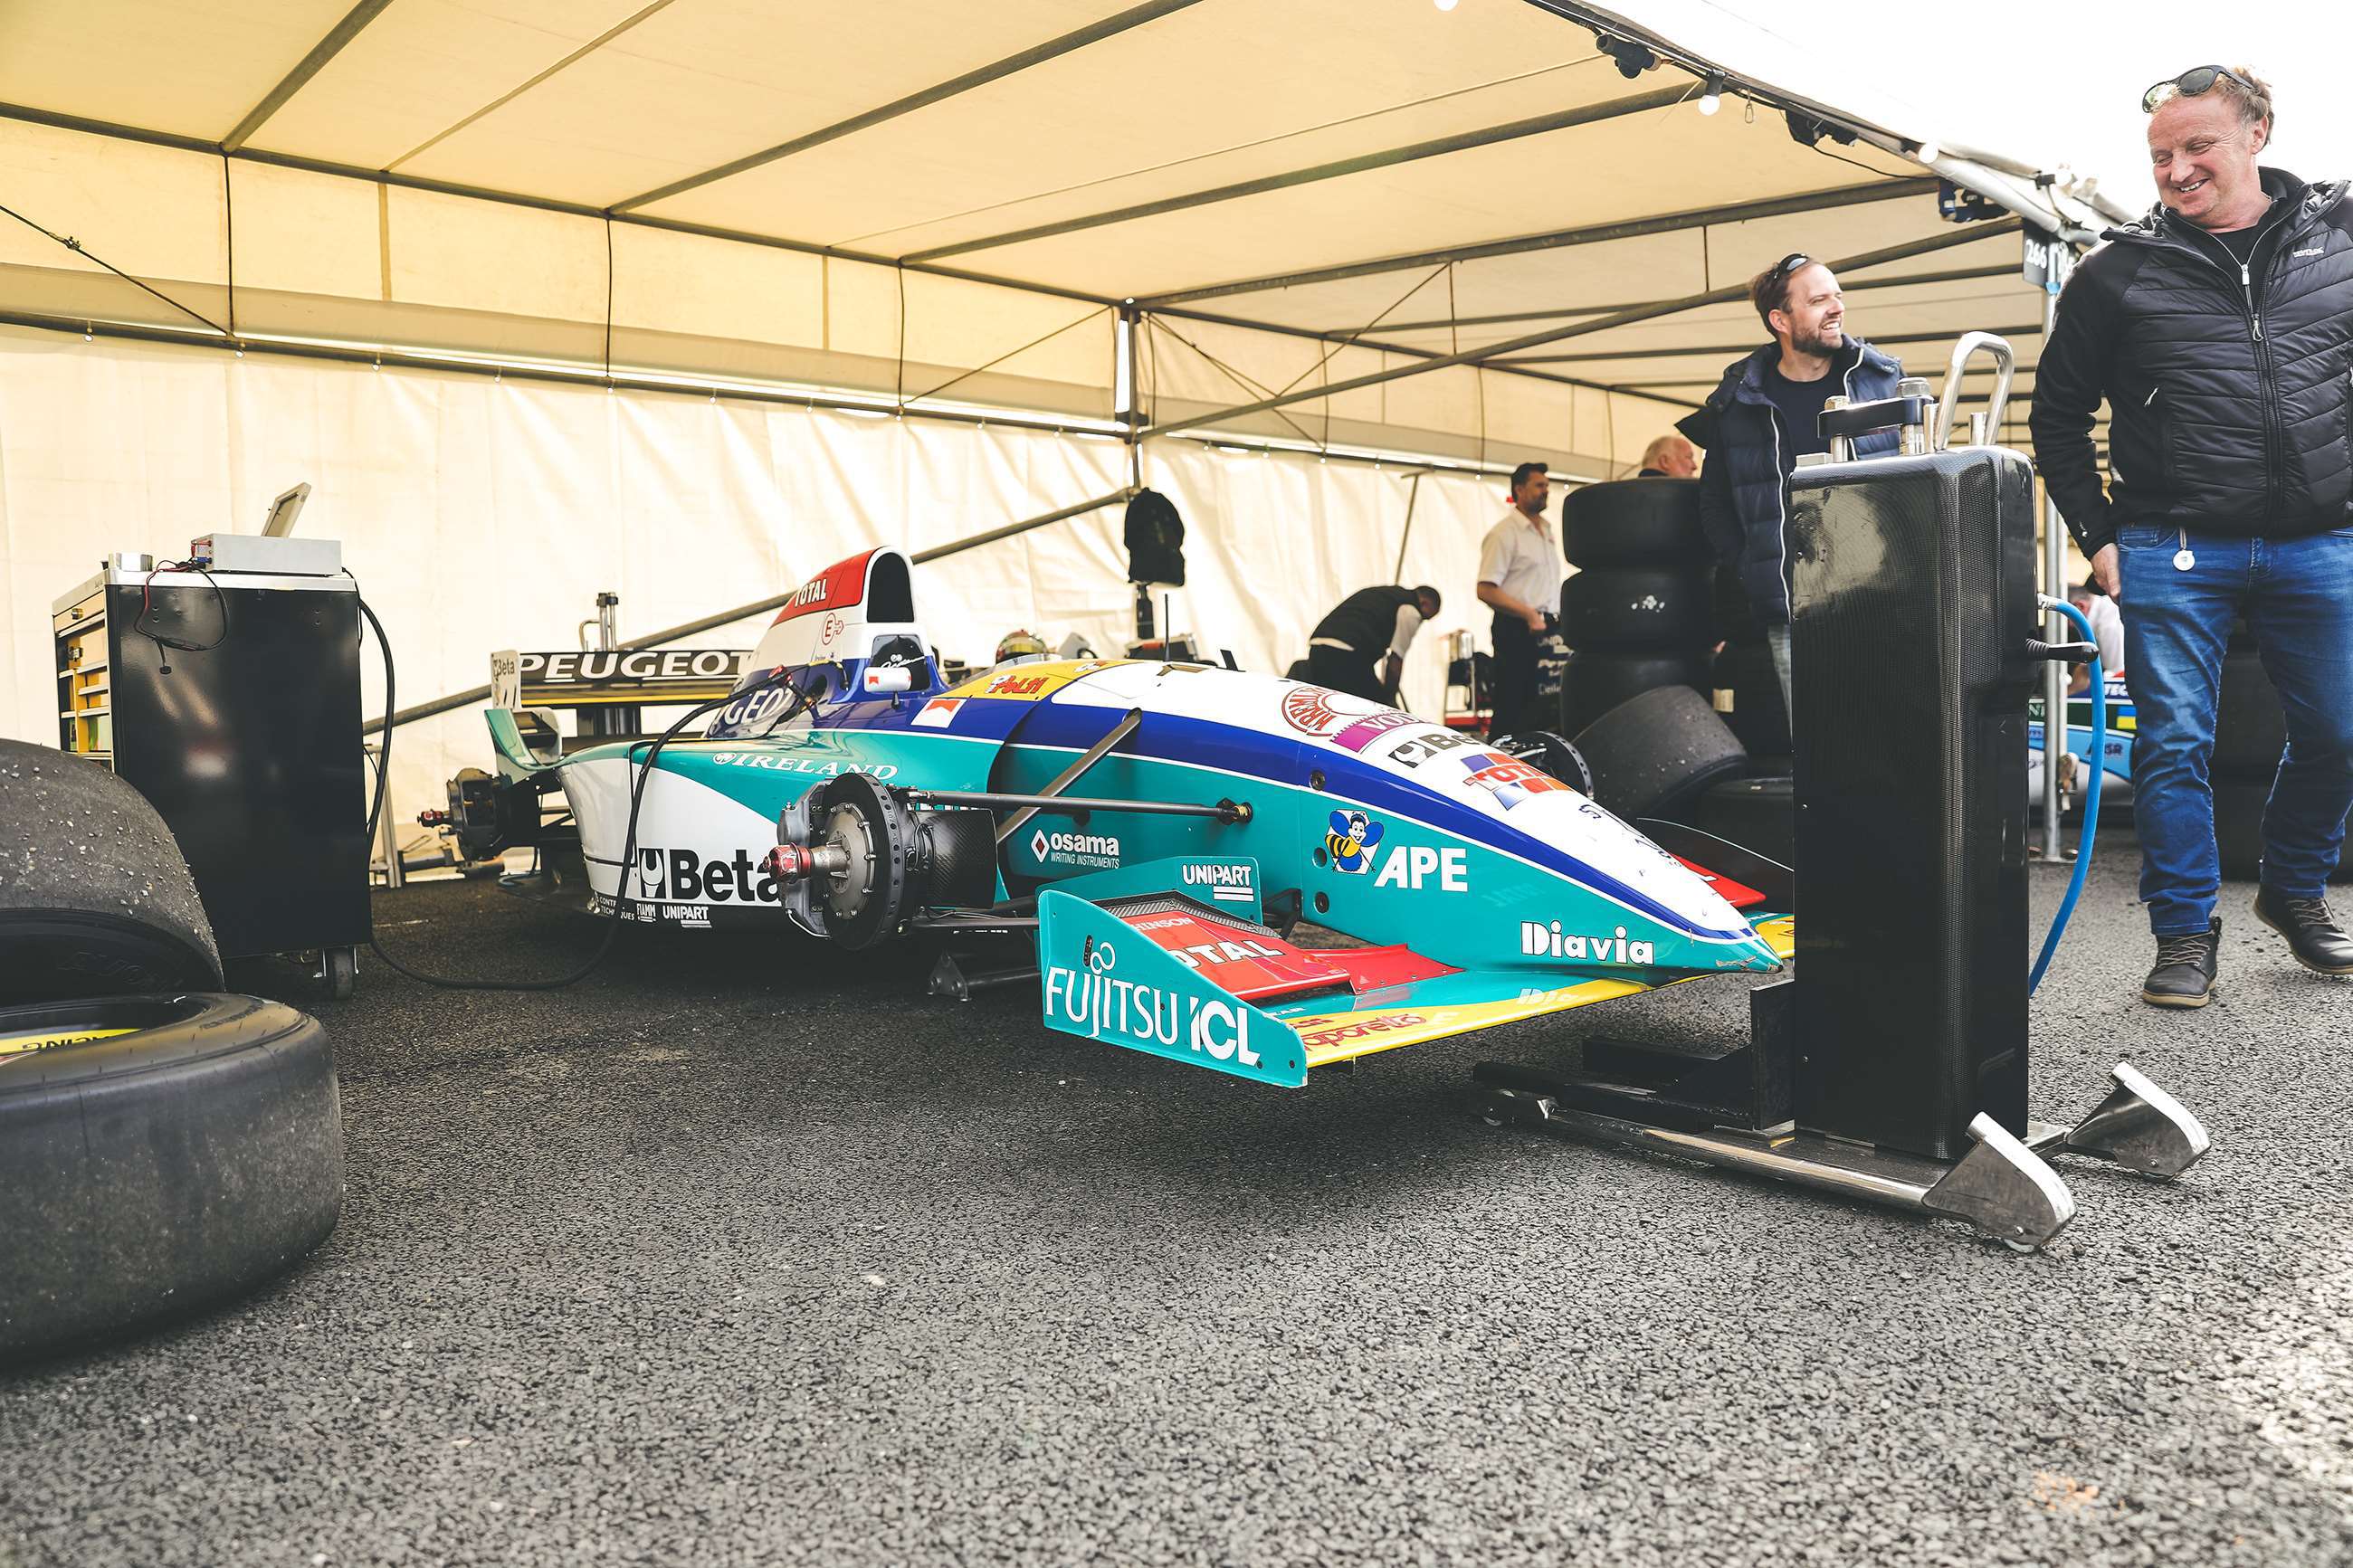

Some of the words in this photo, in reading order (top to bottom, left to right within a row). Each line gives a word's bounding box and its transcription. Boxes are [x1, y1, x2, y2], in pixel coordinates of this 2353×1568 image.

[795, 578, 827, 608] TOTAL
[520, 651, 750, 679] PEUGEOT
[731, 753, 899, 780] IRELAND
[1051, 832, 1119, 856] osama
[1051, 852, 1075, 864] WRITING
[1076, 855, 1119, 870] INSTRUMENTS
[1373, 846, 1468, 892] APE
[670, 849, 780, 902] Beta
[1182, 864, 1252, 886] UNIPART
[662, 905, 709, 919] UNIPART
[1132, 917, 1192, 932] HINSON
[1520, 920, 1654, 965] Diavia
[1045, 965, 1178, 1045] FUJITSU
[1189, 996, 1261, 1066] ICL
